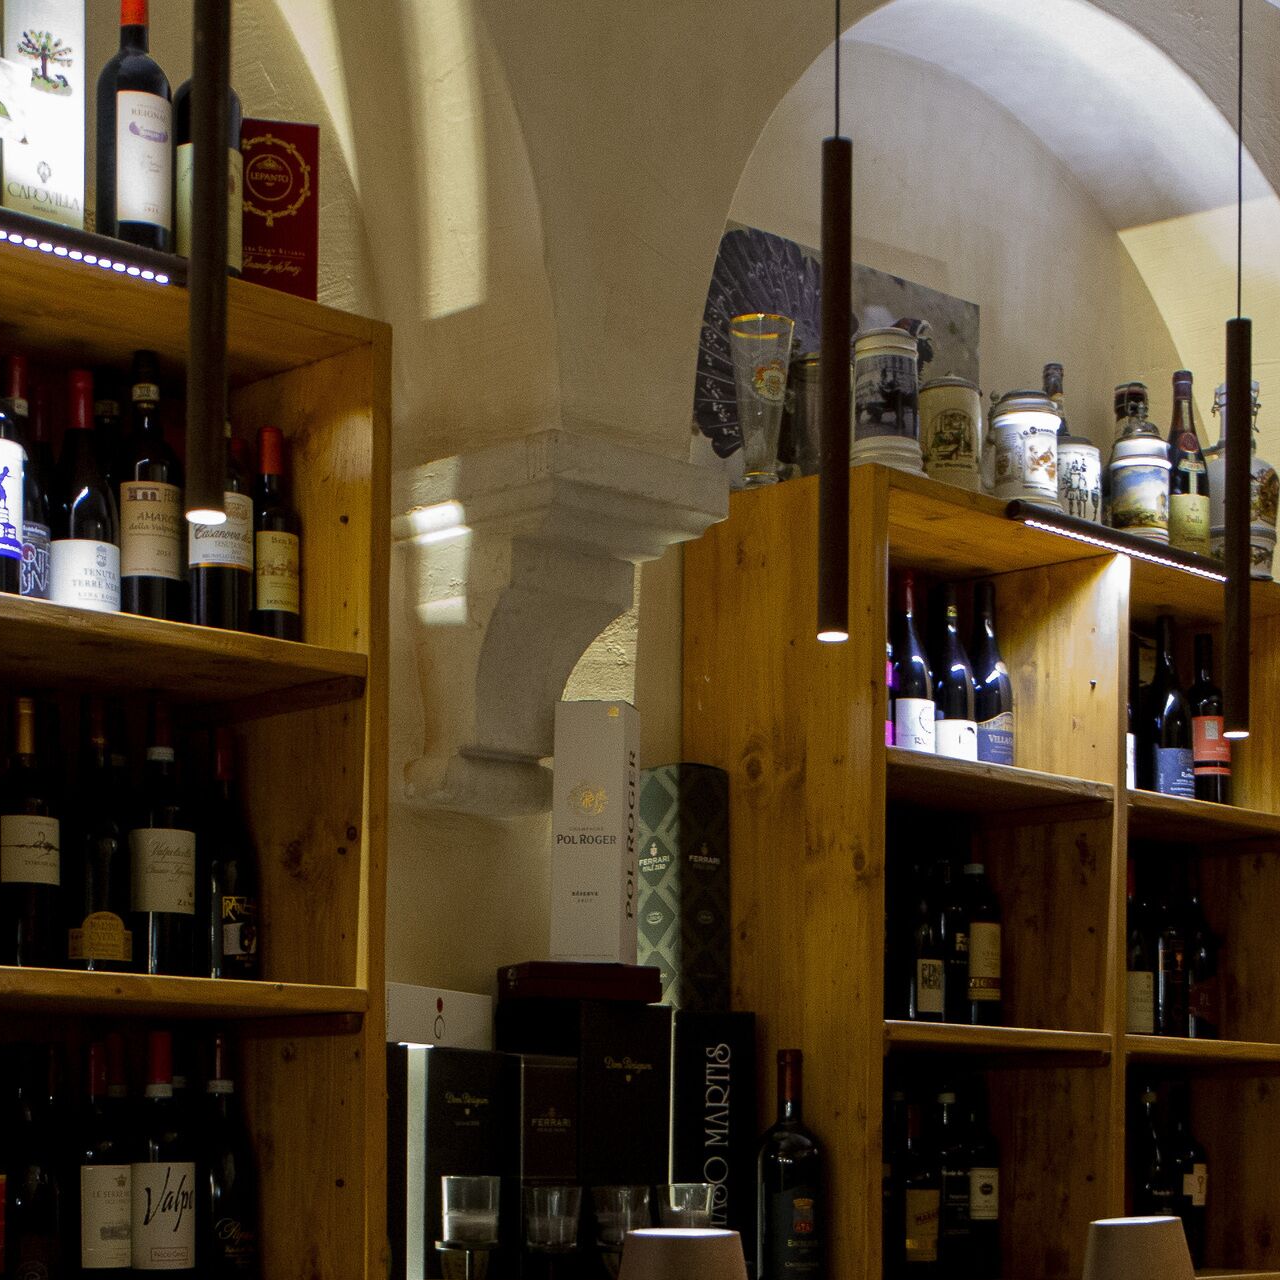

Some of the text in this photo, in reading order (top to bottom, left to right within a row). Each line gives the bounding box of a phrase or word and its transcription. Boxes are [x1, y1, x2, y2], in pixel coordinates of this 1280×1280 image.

[250, 171, 289, 184] LEPANTO
[7, 182, 80, 212] CAPOVILLA
[83, 567, 116, 581] TENUTA
[72, 579, 100, 594] TERRE
[556, 834, 617, 845] POL ROGER
[626, 750, 637, 920] POL ROGER
[639, 855, 670, 867] FERRARI
[688, 855, 722, 865] FERRARI
[704, 1043, 732, 1148] MARTIS
[531, 1117, 572, 1129] FERRARI
